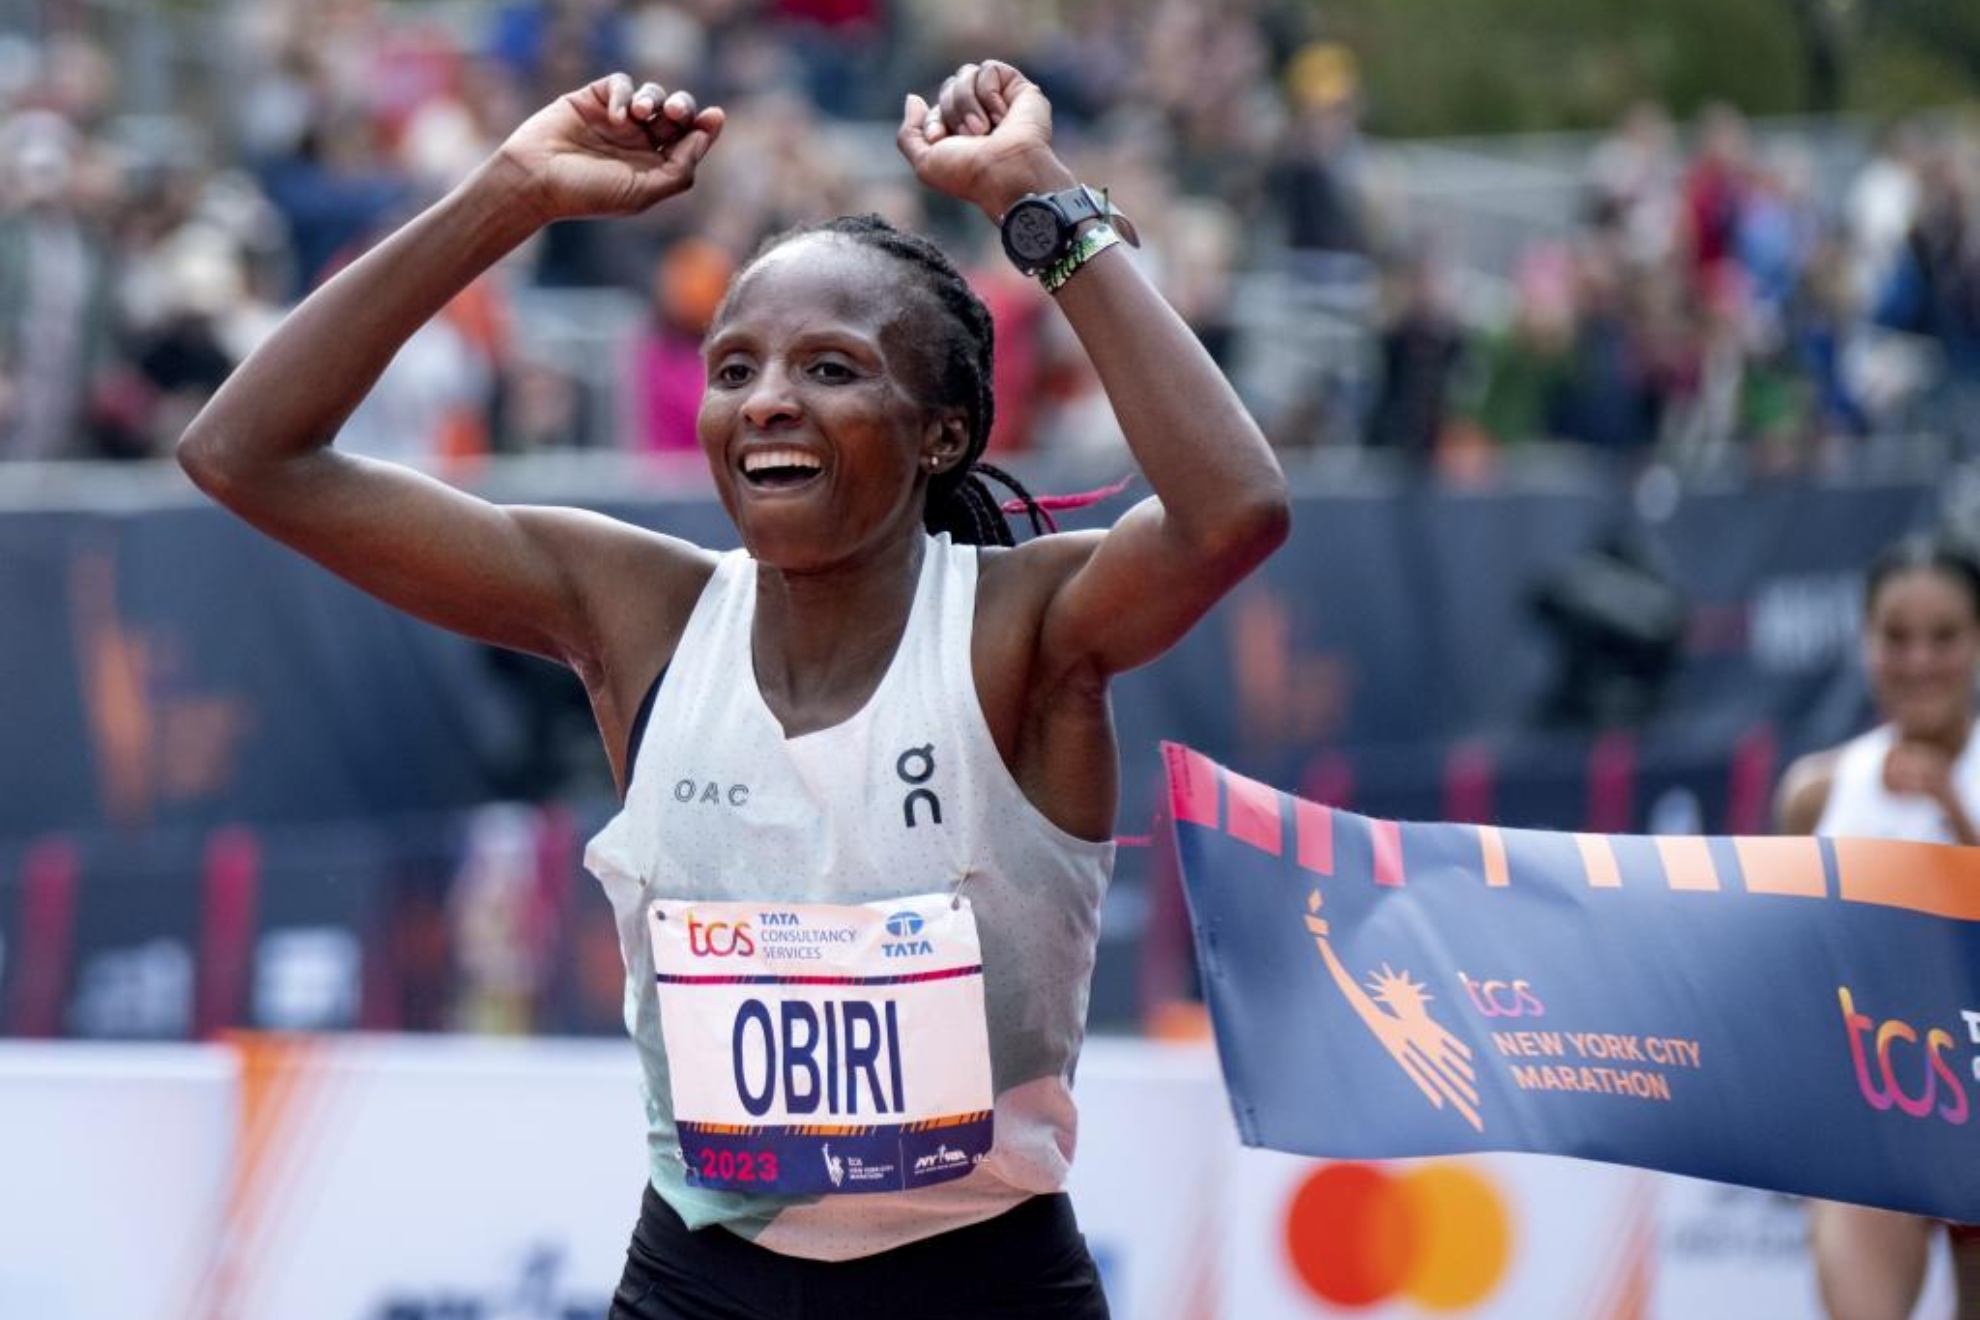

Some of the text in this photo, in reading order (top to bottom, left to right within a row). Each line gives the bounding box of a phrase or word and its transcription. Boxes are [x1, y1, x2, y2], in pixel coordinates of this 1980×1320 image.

[674, 778, 750, 807] OAC
[688, 912, 756, 958] tcs
[759, 913, 799, 926] TATA
[761, 929, 857, 943] CONSULTANCY
[763, 946, 821, 960] SERVICES
[881, 940, 933, 958] TATA
[1457, 970, 1546, 1018] tcs
[732, 998, 906, 1118] OBIRI
[1492, 1031, 1702, 1068] NEW YORK CITY
[1838, 985, 1970, 1126] tcs
[1510, 1065, 1672, 1101] MARATHON
[700, 1148, 778, 1182] 2023
